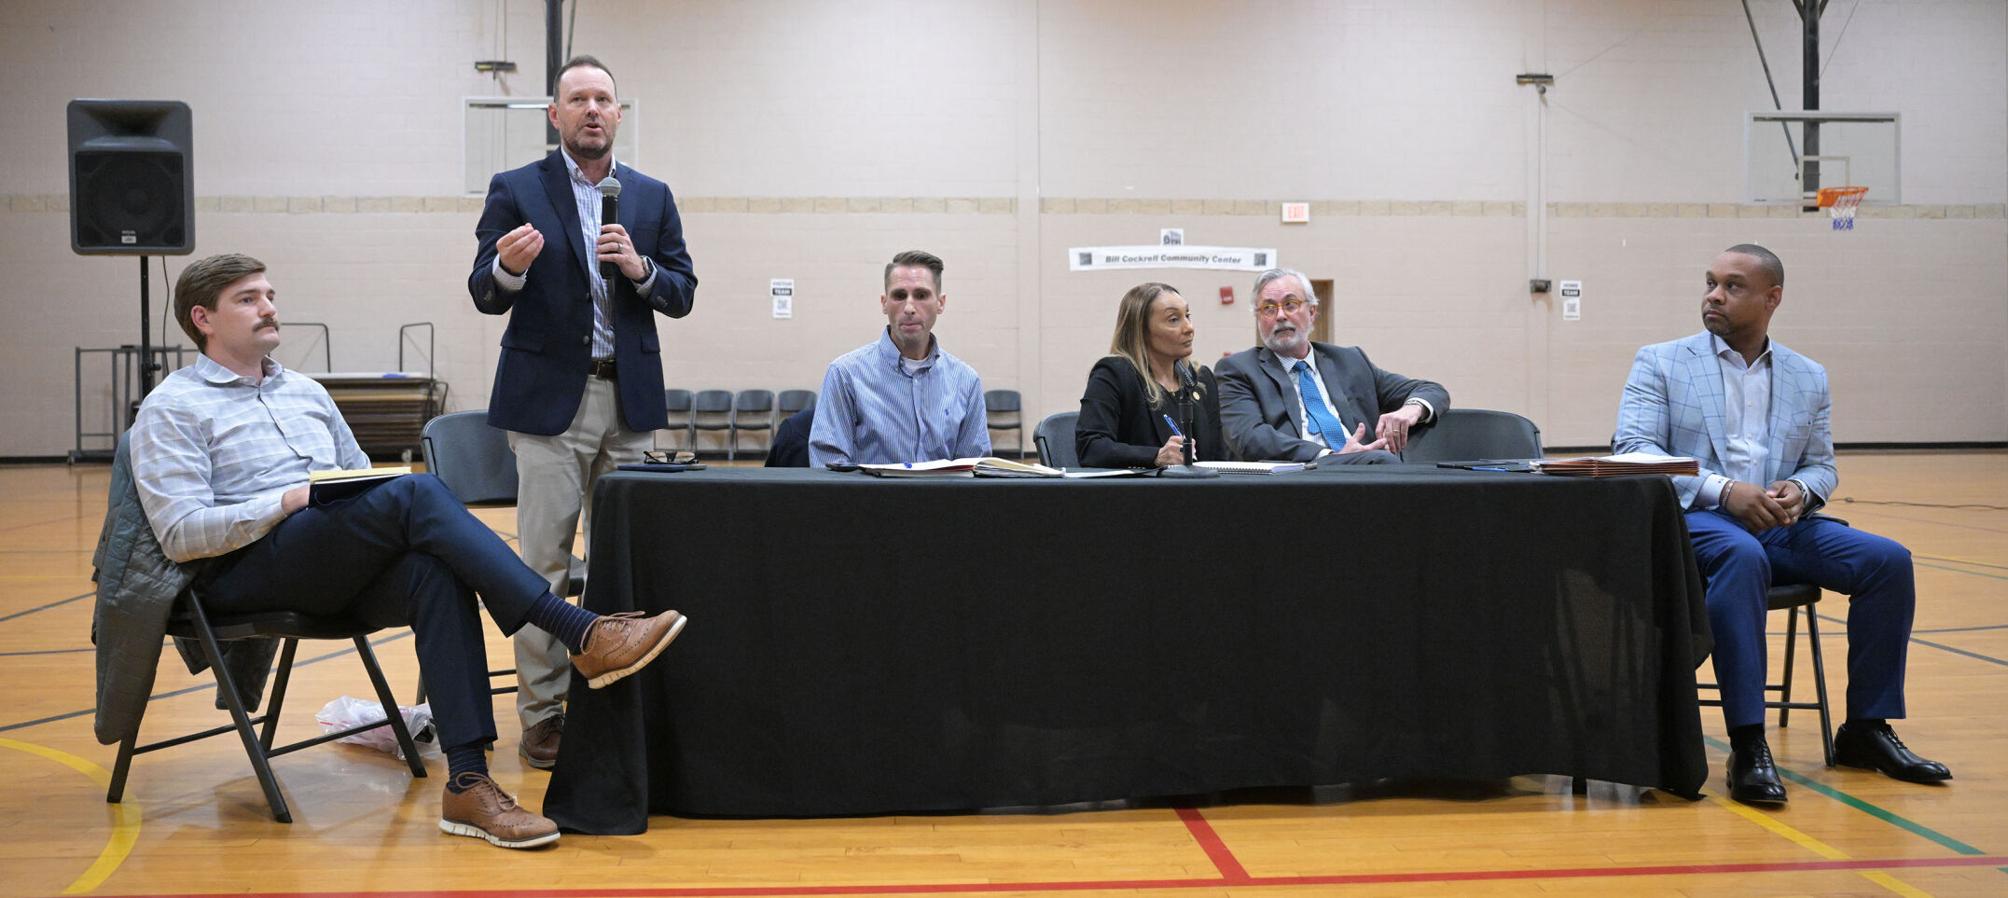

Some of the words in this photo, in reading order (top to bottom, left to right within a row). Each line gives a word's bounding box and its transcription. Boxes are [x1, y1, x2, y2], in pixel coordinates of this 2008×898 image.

[1105, 255, 1120, 263] Bill
[1122, 255, 1159, 263] Cockrell
[1160, 254, 1209, 264] Community
[1212, 255, 1241, 264] Center
